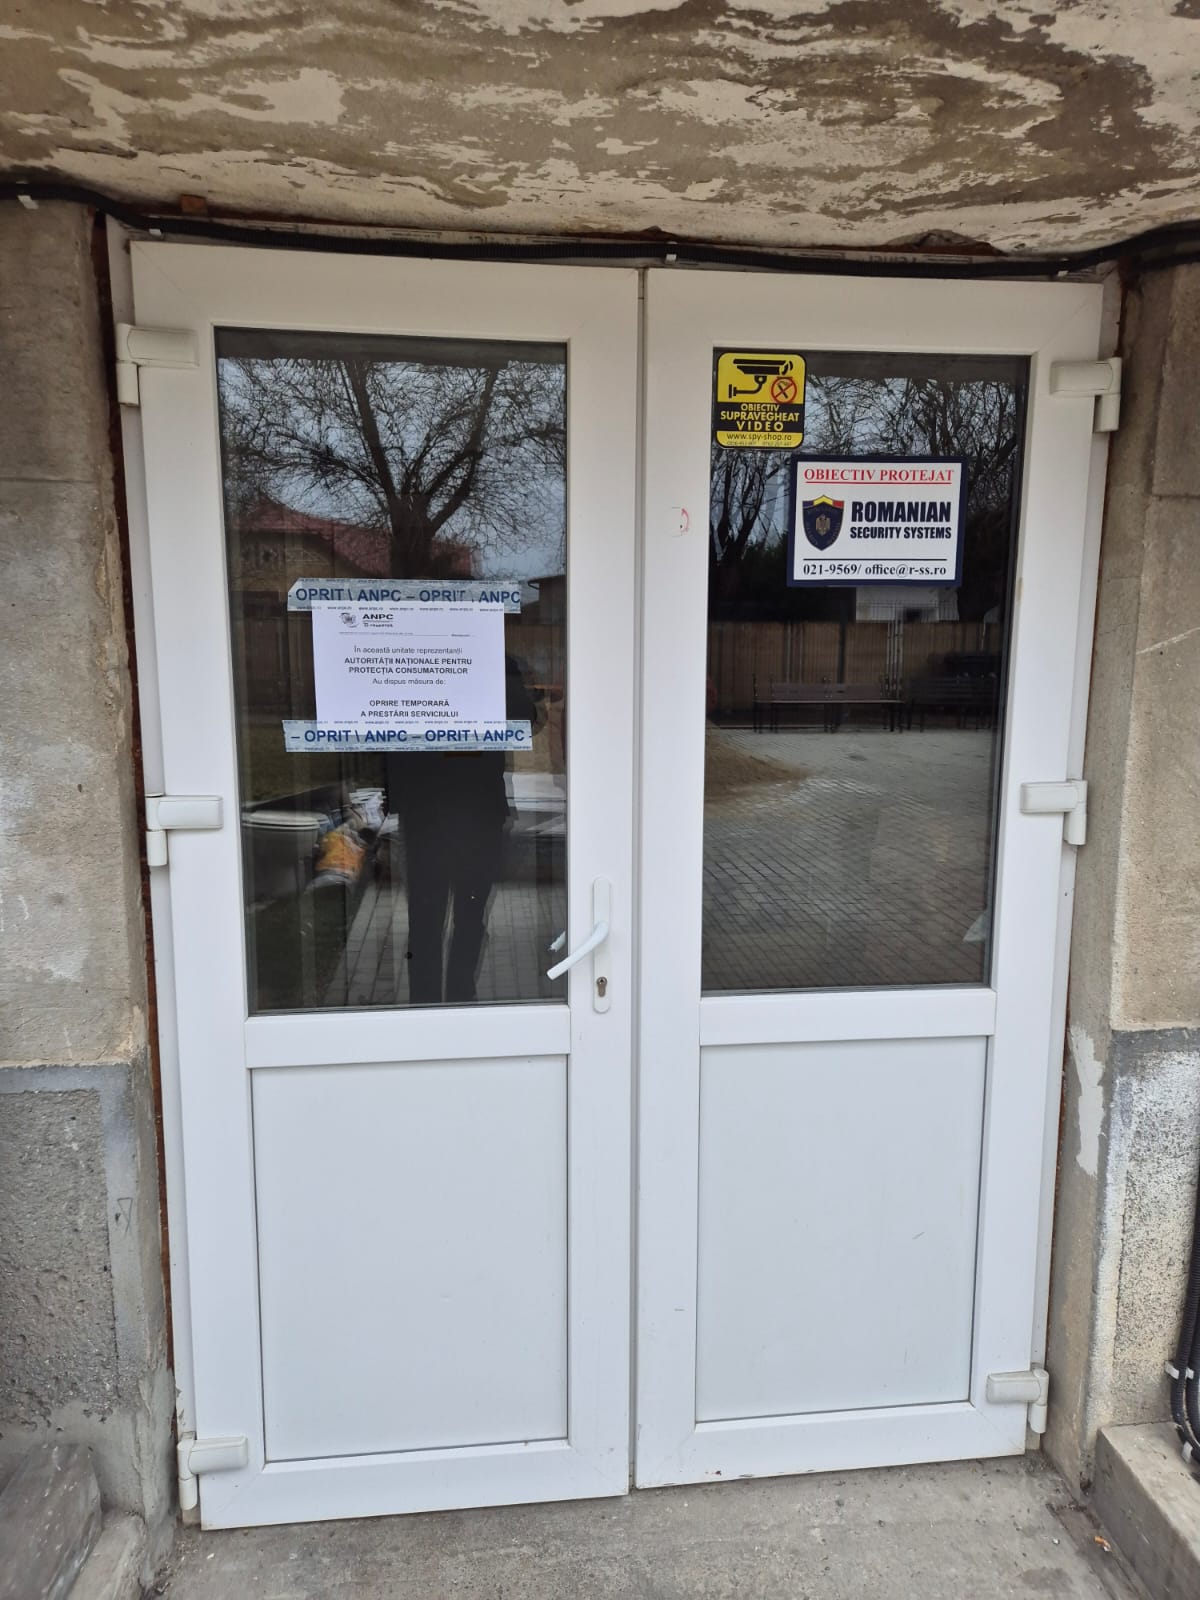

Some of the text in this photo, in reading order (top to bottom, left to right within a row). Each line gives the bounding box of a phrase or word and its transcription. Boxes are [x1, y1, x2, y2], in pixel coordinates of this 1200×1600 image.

[740, 403, 780, 412] OBIECTIV
[720, 411, 800, 422] SUPRAVEGHEAT
[736, 421, 784, 432] VIDEO
[726, 433, 792, 441] www.spy-shop.ro
[804, 468, 954, 482] OBIECTIV PROTEJAT
[851, 501, 952, 523] ROMANIAN
[850, 526, 952, 539] SECURITY SYSTEMS
[803, 563, 946, 578] 021-9569/ office@r-ss.ro
[295, 588, 344, 601] OPRIT
[357, 589, 402, 602] ANPC
[419, 590, 466, 602] OPRIT
[478, 591, 521, 603] ANPC
[348, 666, 394, 675] PROTECȚIA
[400, 699, 450, 707] TEMPORARĂ
[368, 710, 409, 718] PRESTĂRII
[304, 729, 352, 743] OPRIT
[364, 729, 408, 743] ANPC
[424, 729, 471, 742] OPRIT
[483, 729, 525, 742] ANPC
